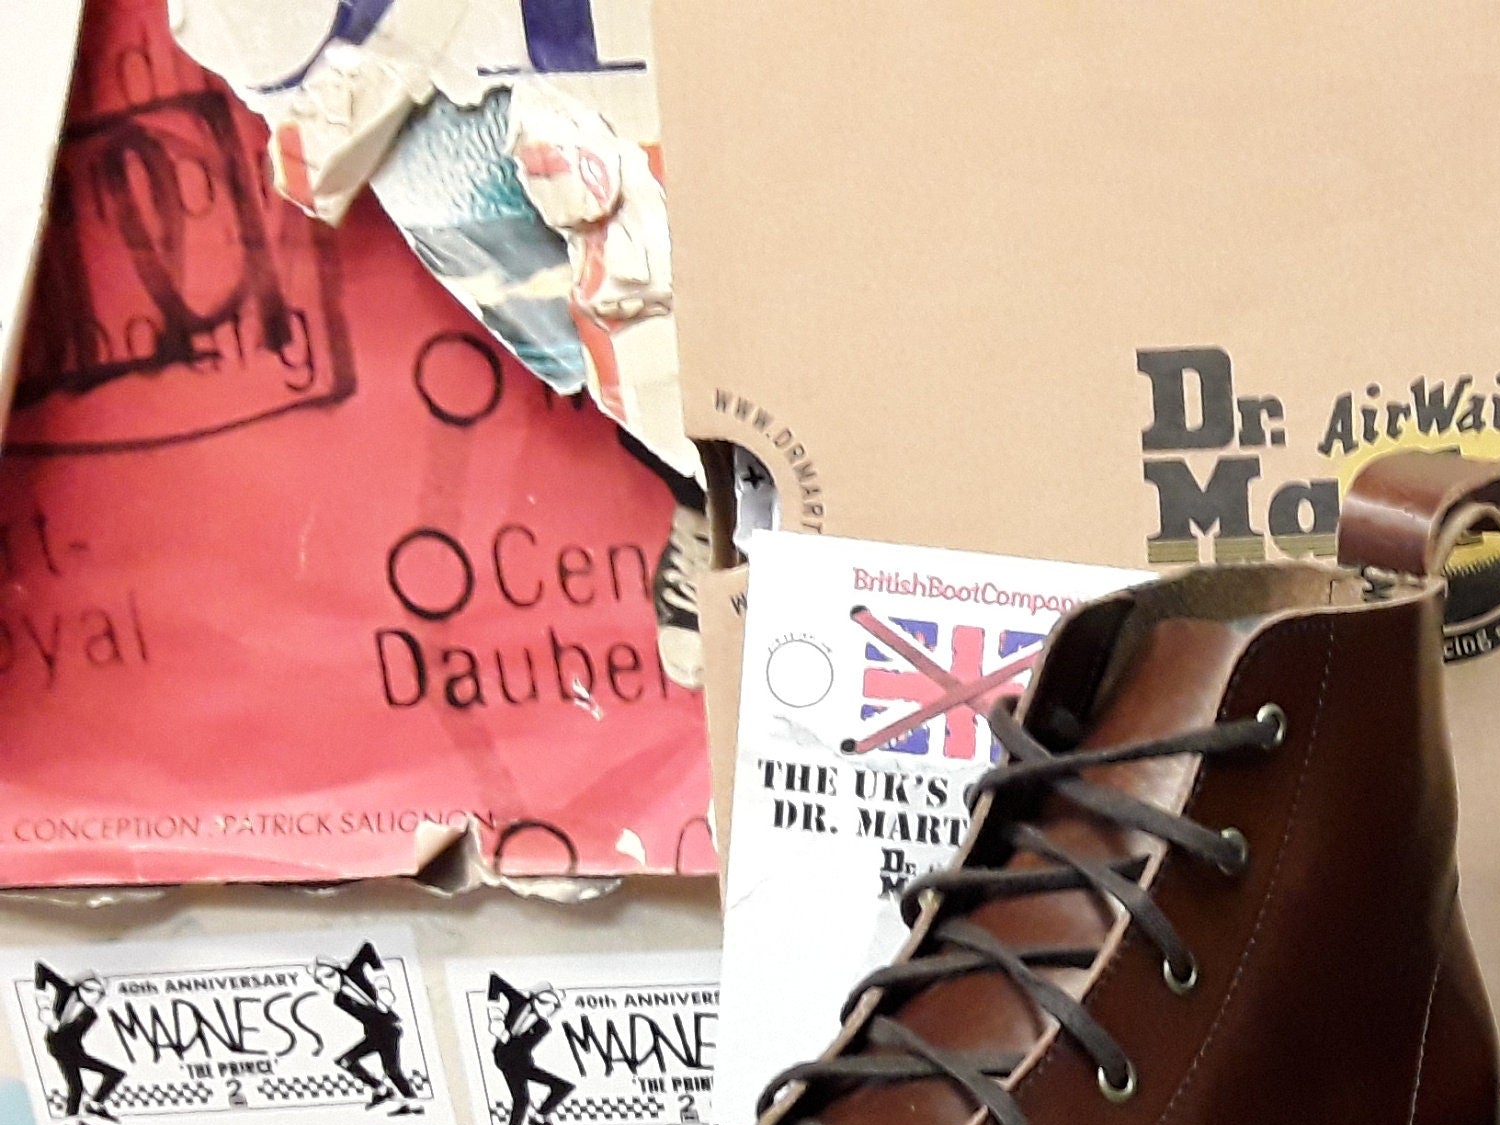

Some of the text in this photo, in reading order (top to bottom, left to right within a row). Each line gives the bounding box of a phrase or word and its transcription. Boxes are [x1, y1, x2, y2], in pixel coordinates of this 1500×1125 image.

[1136, 346, 1287, 450] Dr.
[757, 758, 838, 797] THE
[854, 768, 950, 811] UK'S
[222, 811, 331, 836] PATRICK
[772, 797, 838, 836] DR.
[164, 970, 300, 994] ANNIVERSARY
[107, 990, 325, 1066] MADNESS
